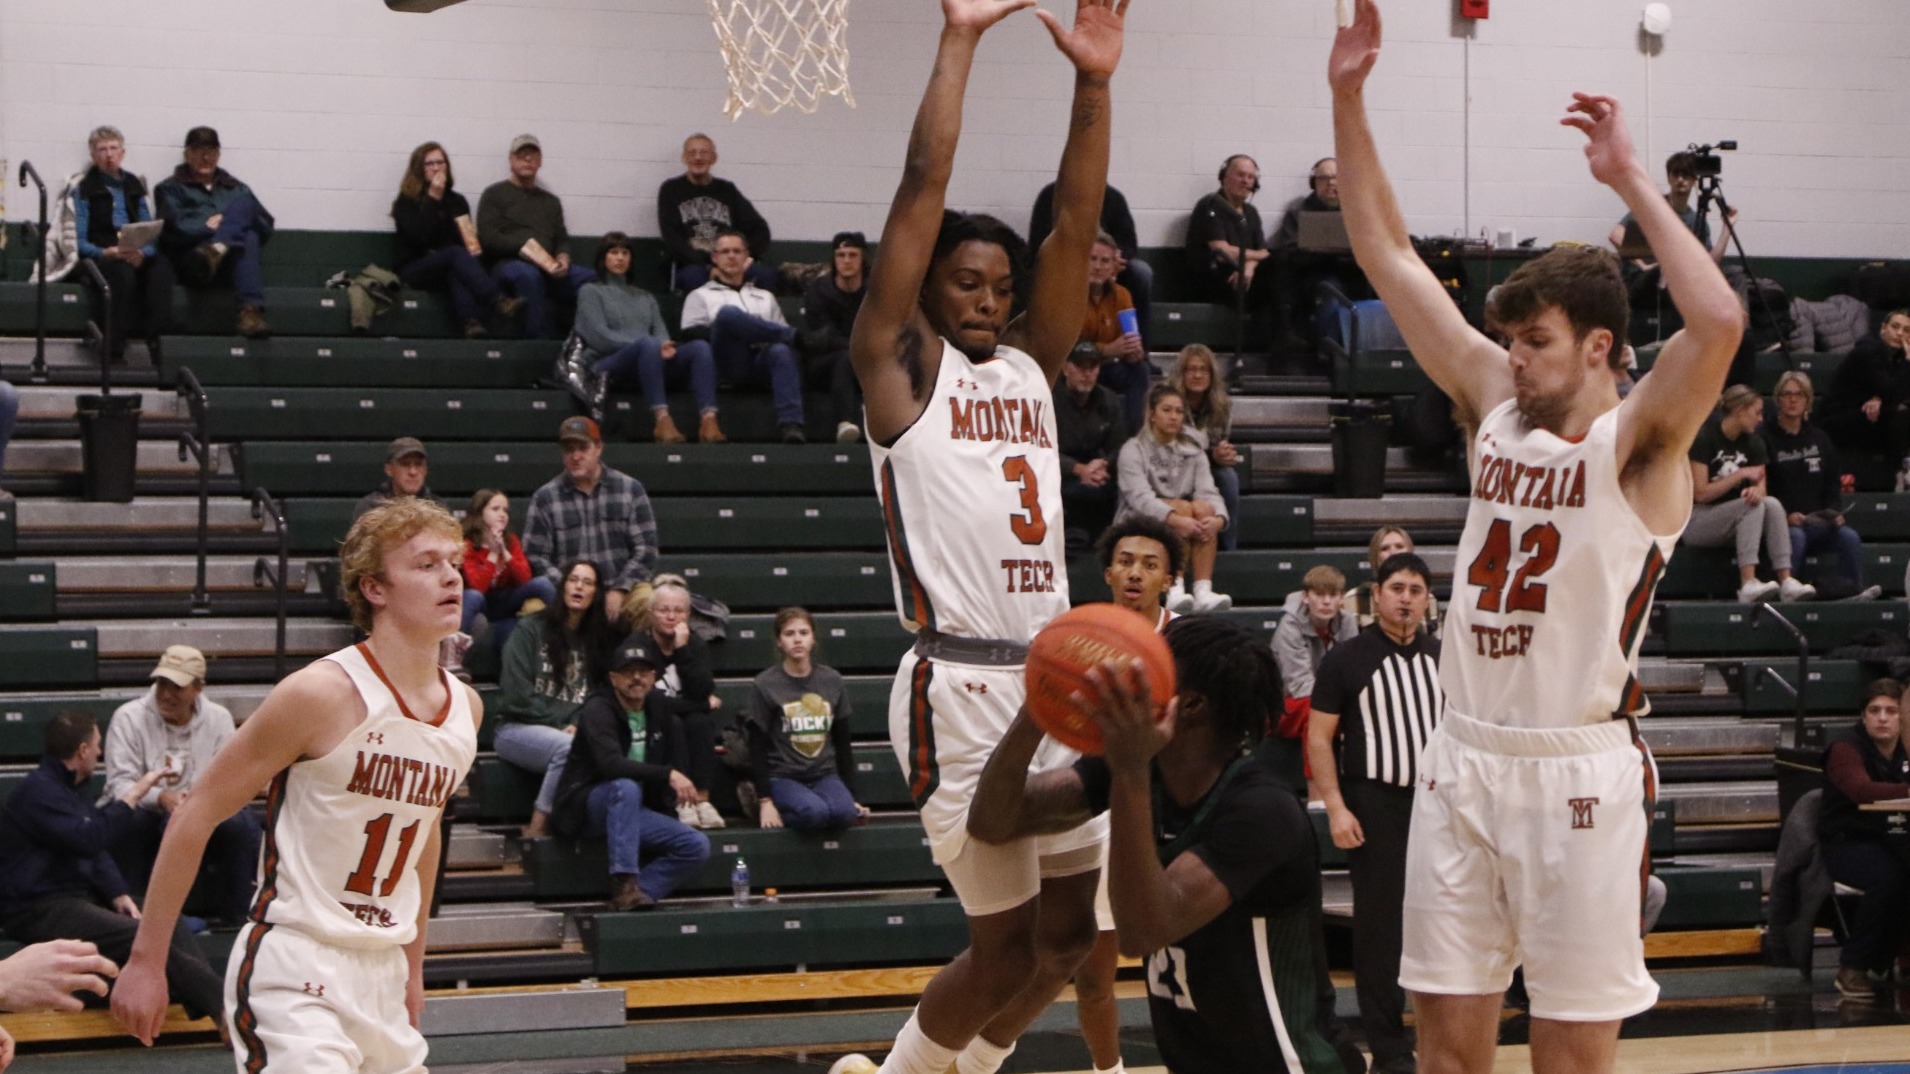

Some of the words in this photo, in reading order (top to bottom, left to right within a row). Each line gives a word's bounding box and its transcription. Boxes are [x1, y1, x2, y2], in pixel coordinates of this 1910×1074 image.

[1001, 455, 1047, 545] 3
[1001, 559, 1056, 593] TECH
[1467, 518, 1562, 614] 42
[1471, 624, 1534, 659] TECH
[344, 812, 421, 897] 11
